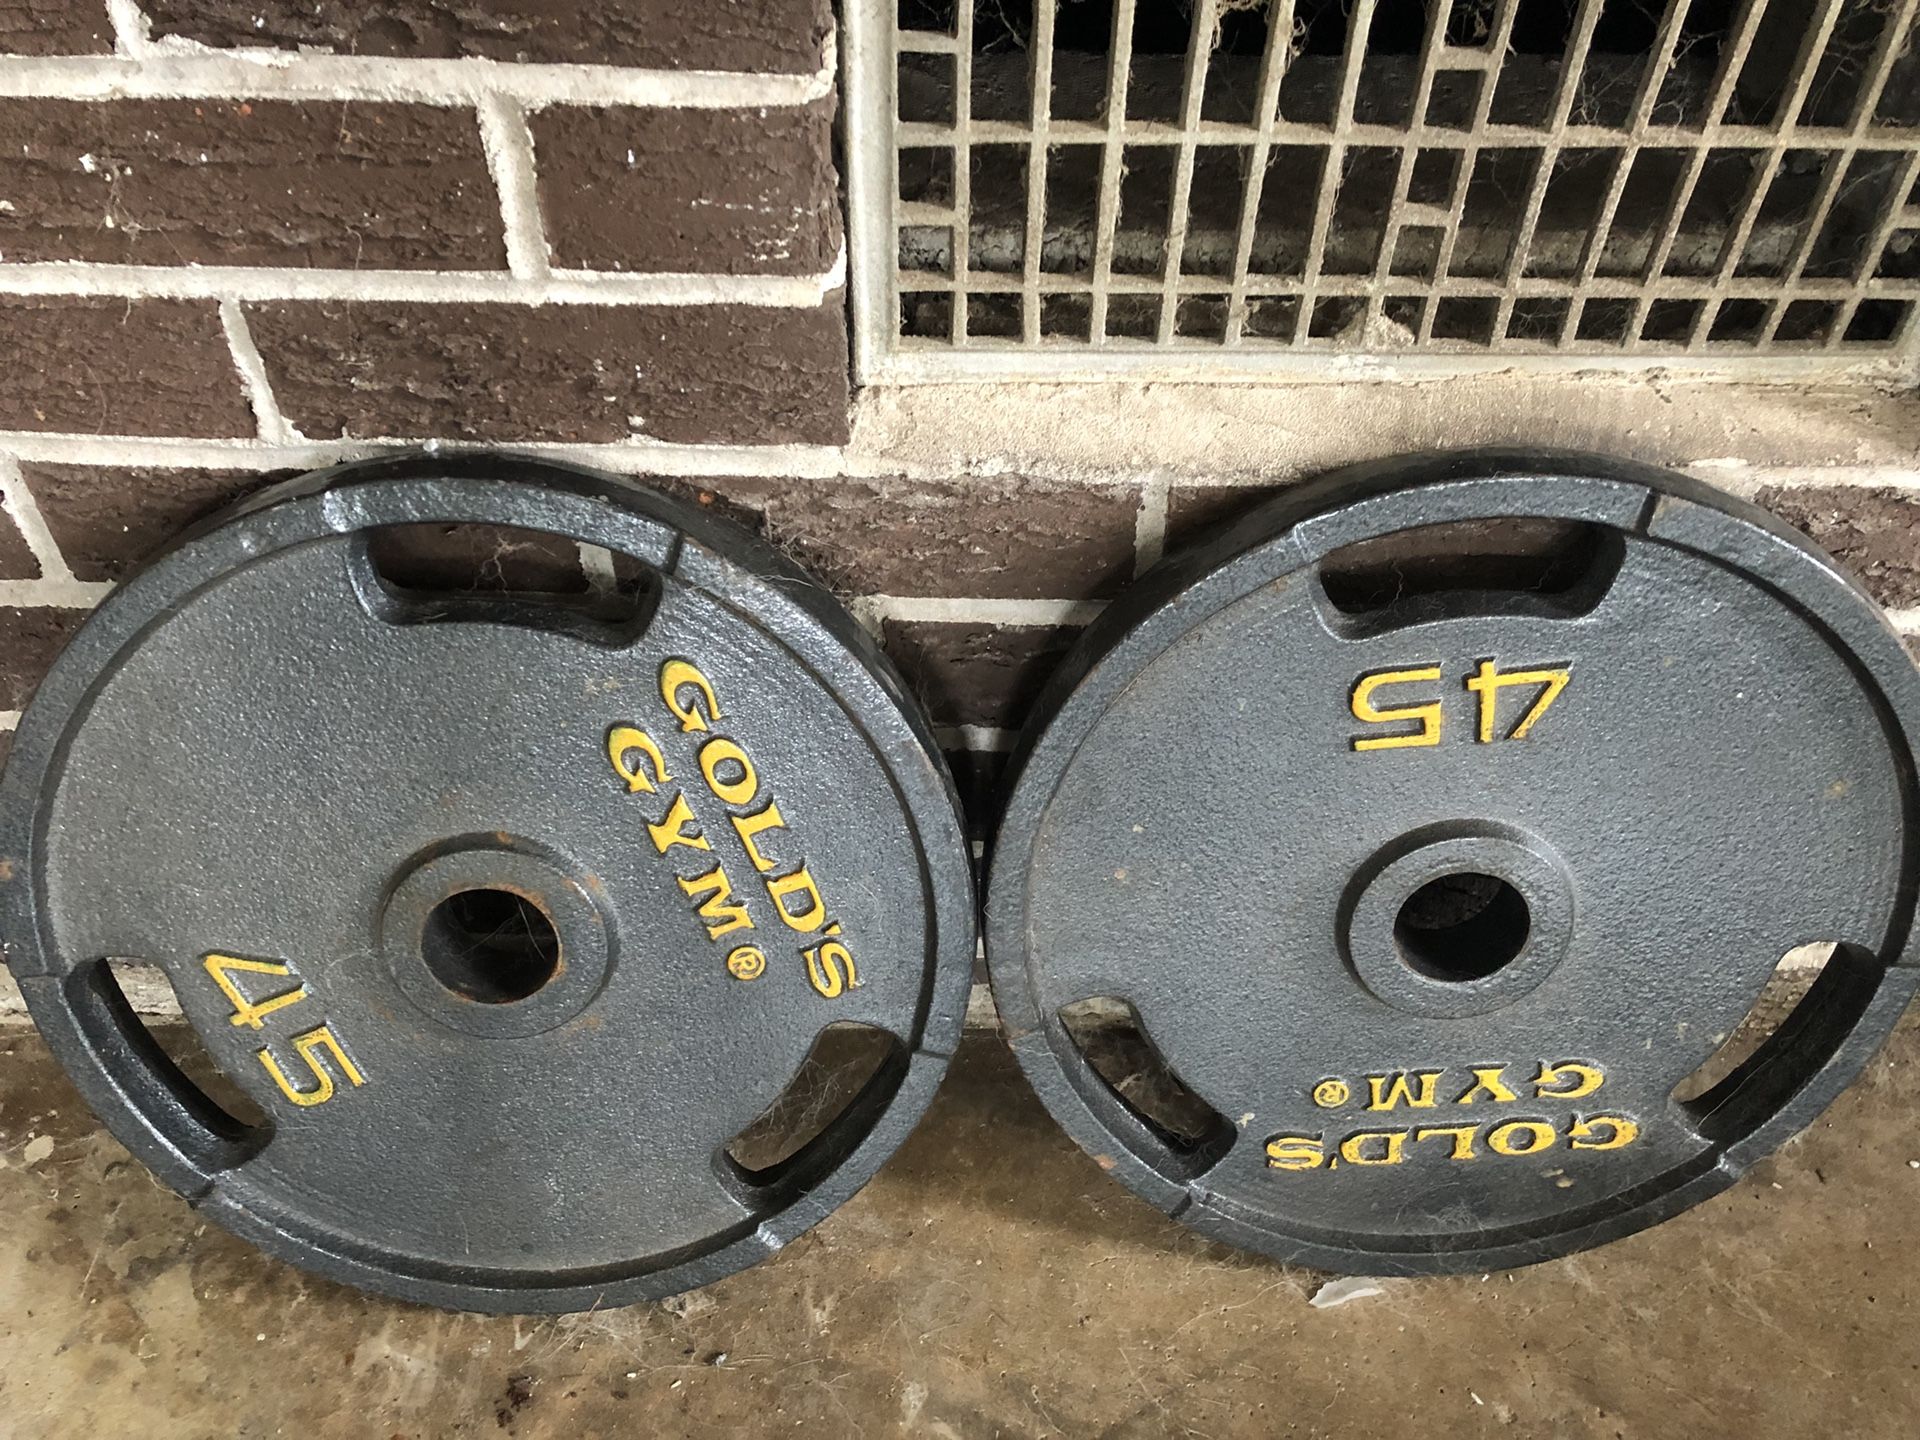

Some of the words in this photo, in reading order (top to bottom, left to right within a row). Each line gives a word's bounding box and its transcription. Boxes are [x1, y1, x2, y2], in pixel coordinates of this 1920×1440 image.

[1352, 660, 1571, 752] 45
[660, 659, 857, 998] GOLD'S
[203, 954, 368, 1107] 45
[1266, 1116, 1640, 1170] GOLD'S
